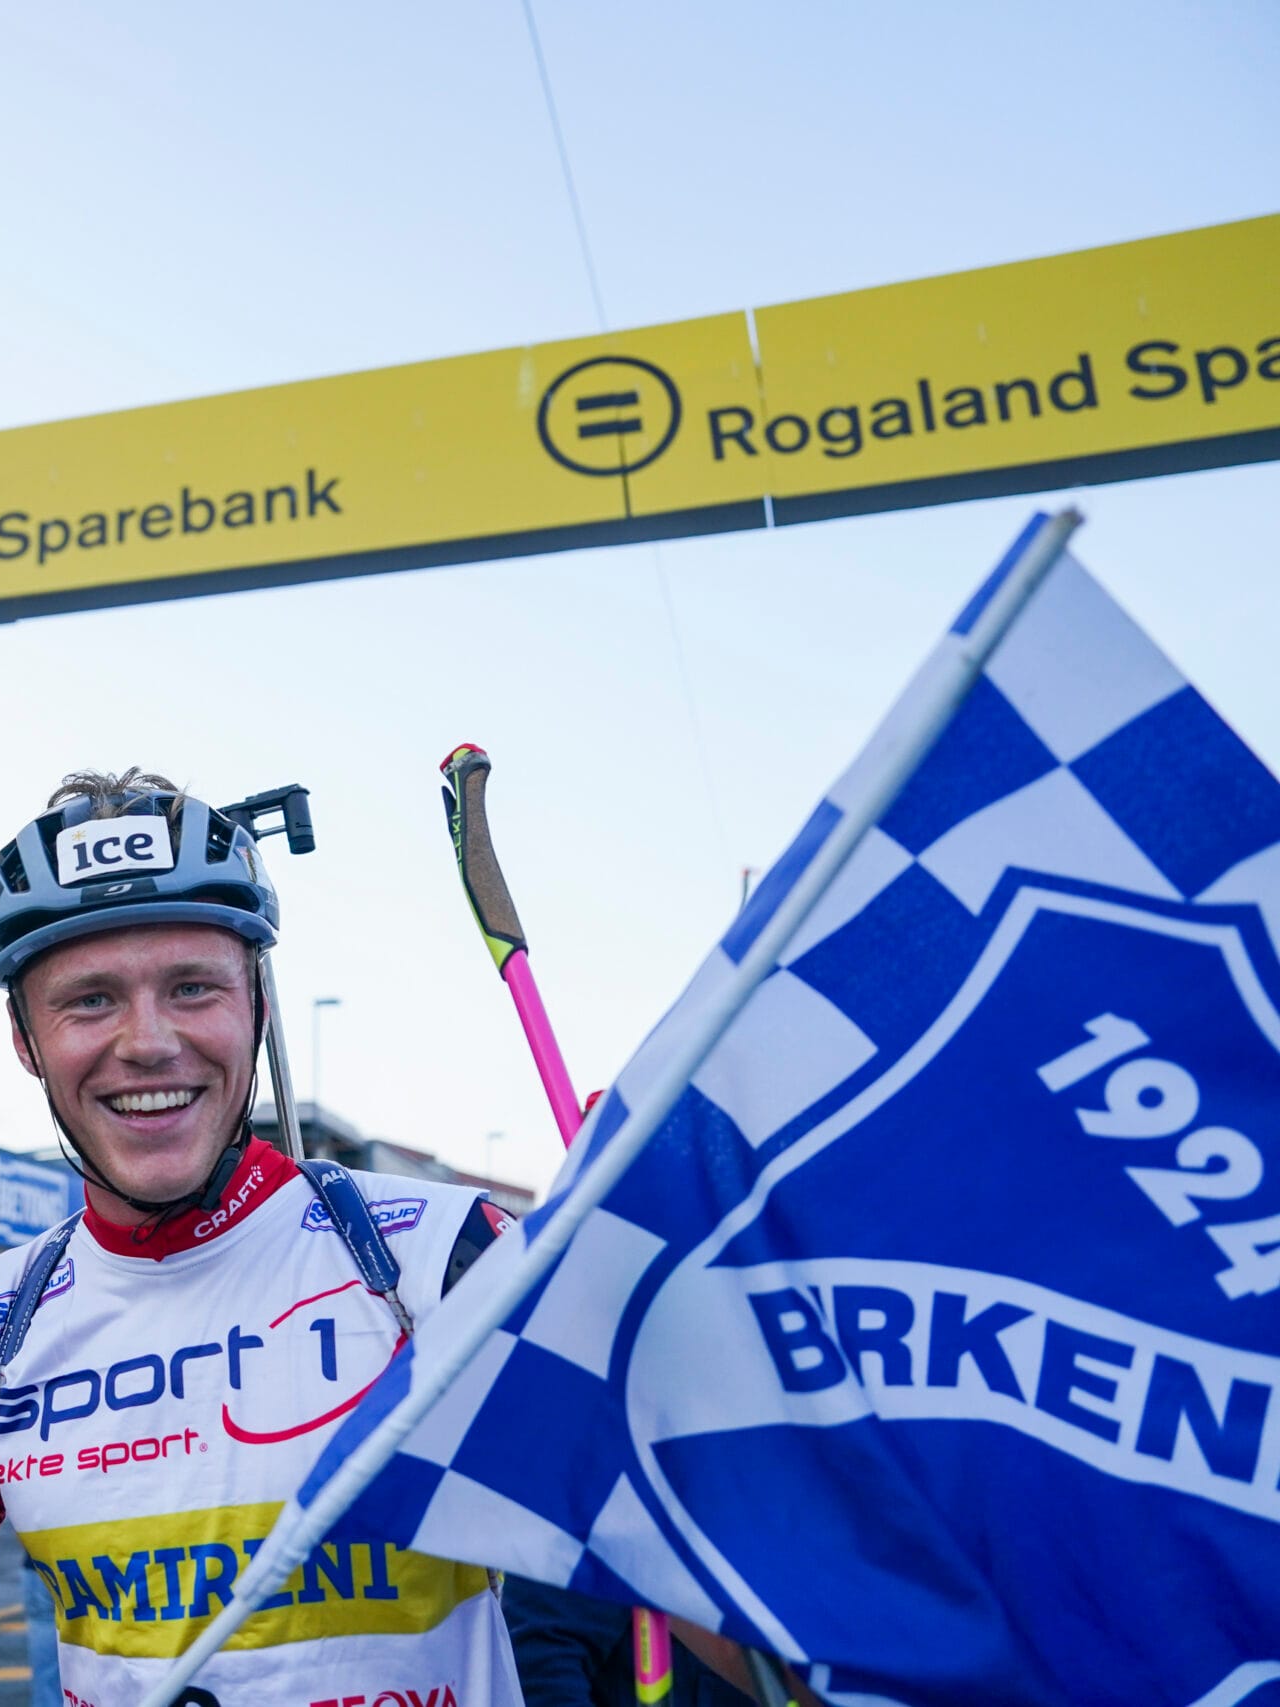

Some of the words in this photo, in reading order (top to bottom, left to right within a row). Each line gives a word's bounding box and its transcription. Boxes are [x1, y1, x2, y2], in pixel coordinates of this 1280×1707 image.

[708, 354, 1099, 461] Rogaland
[72, 829, 155, 872] ice
[1036, 1012, 1280, 1300] 1924
[194, 1173, 258, 1239] CRAFT
[310, 1317, 338, 1382] 1
[746, 1282, 1280, 1490] BRKEN
